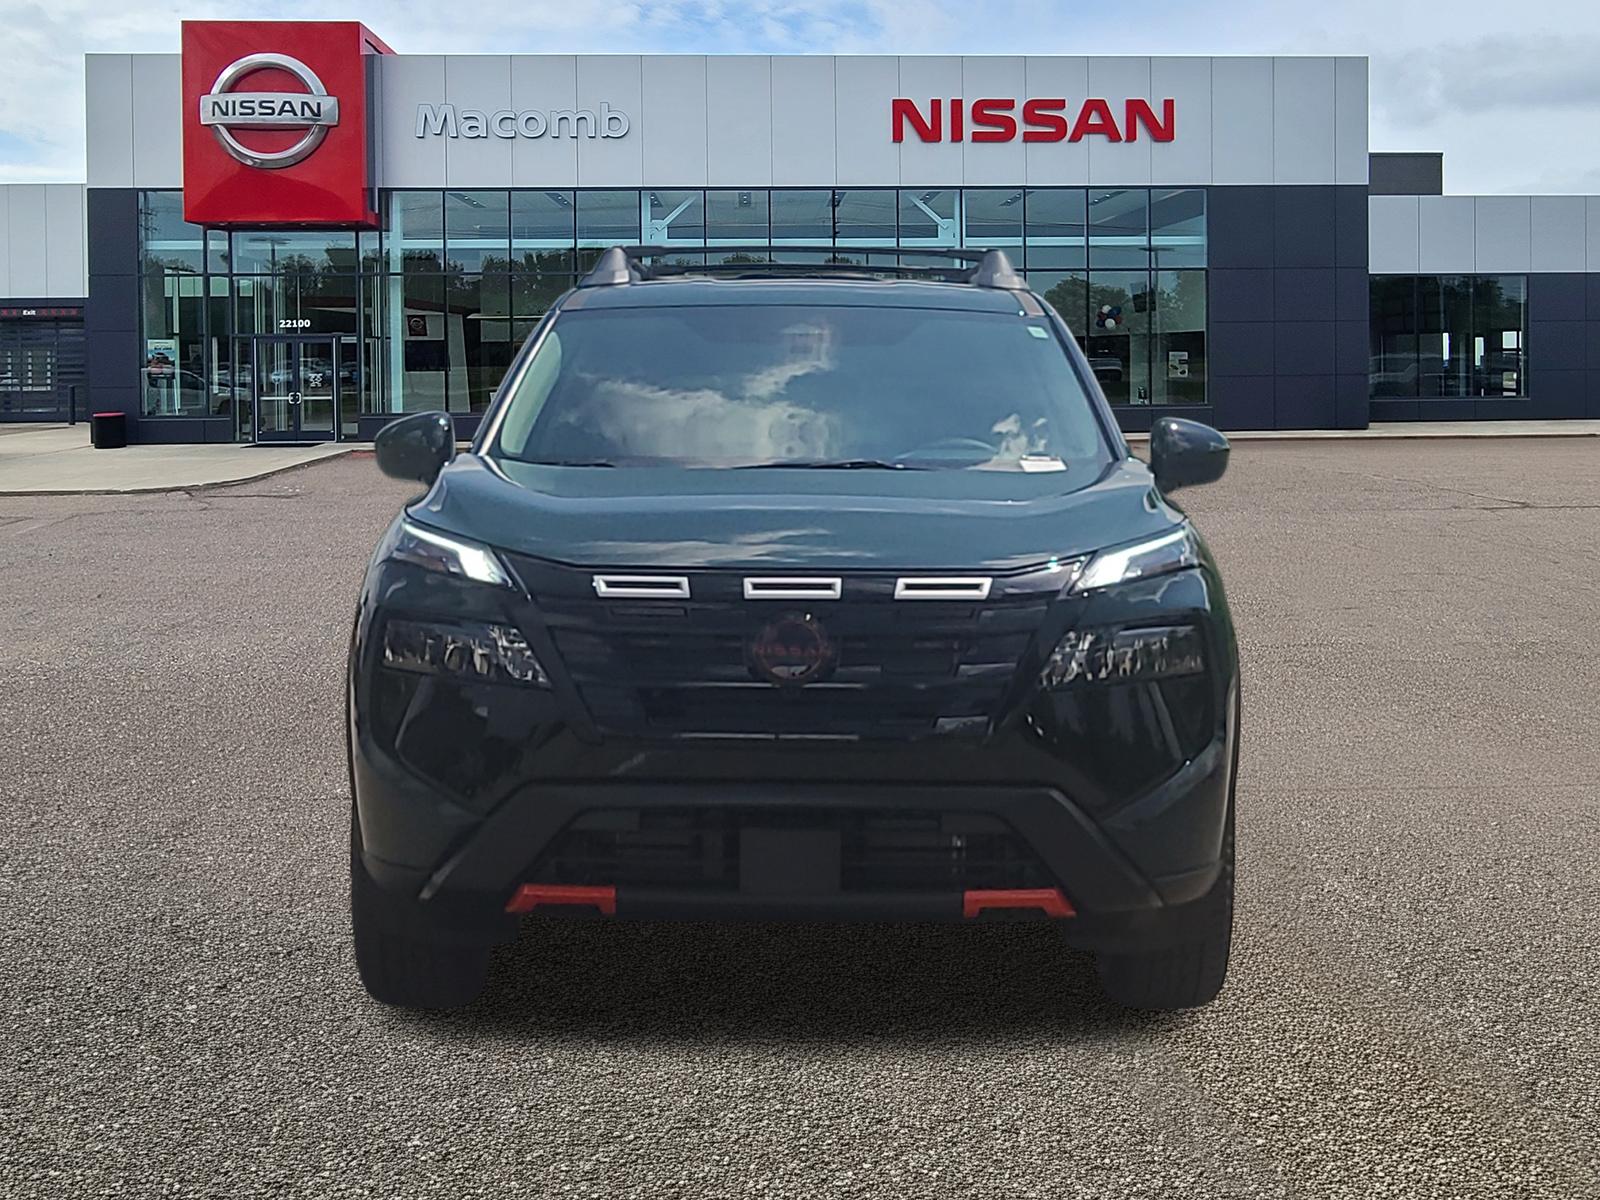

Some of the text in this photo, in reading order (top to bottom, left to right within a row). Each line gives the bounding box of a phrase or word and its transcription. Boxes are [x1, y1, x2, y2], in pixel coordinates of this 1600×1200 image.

[211, 100, 322, 117] NISSAN
[415, 102, 630, 139] Macomb
[892, 99, 1175, 143] NISSAN
[279, 319, 311, 328] 22100
[752, 643, 833, 657] NISSAN
